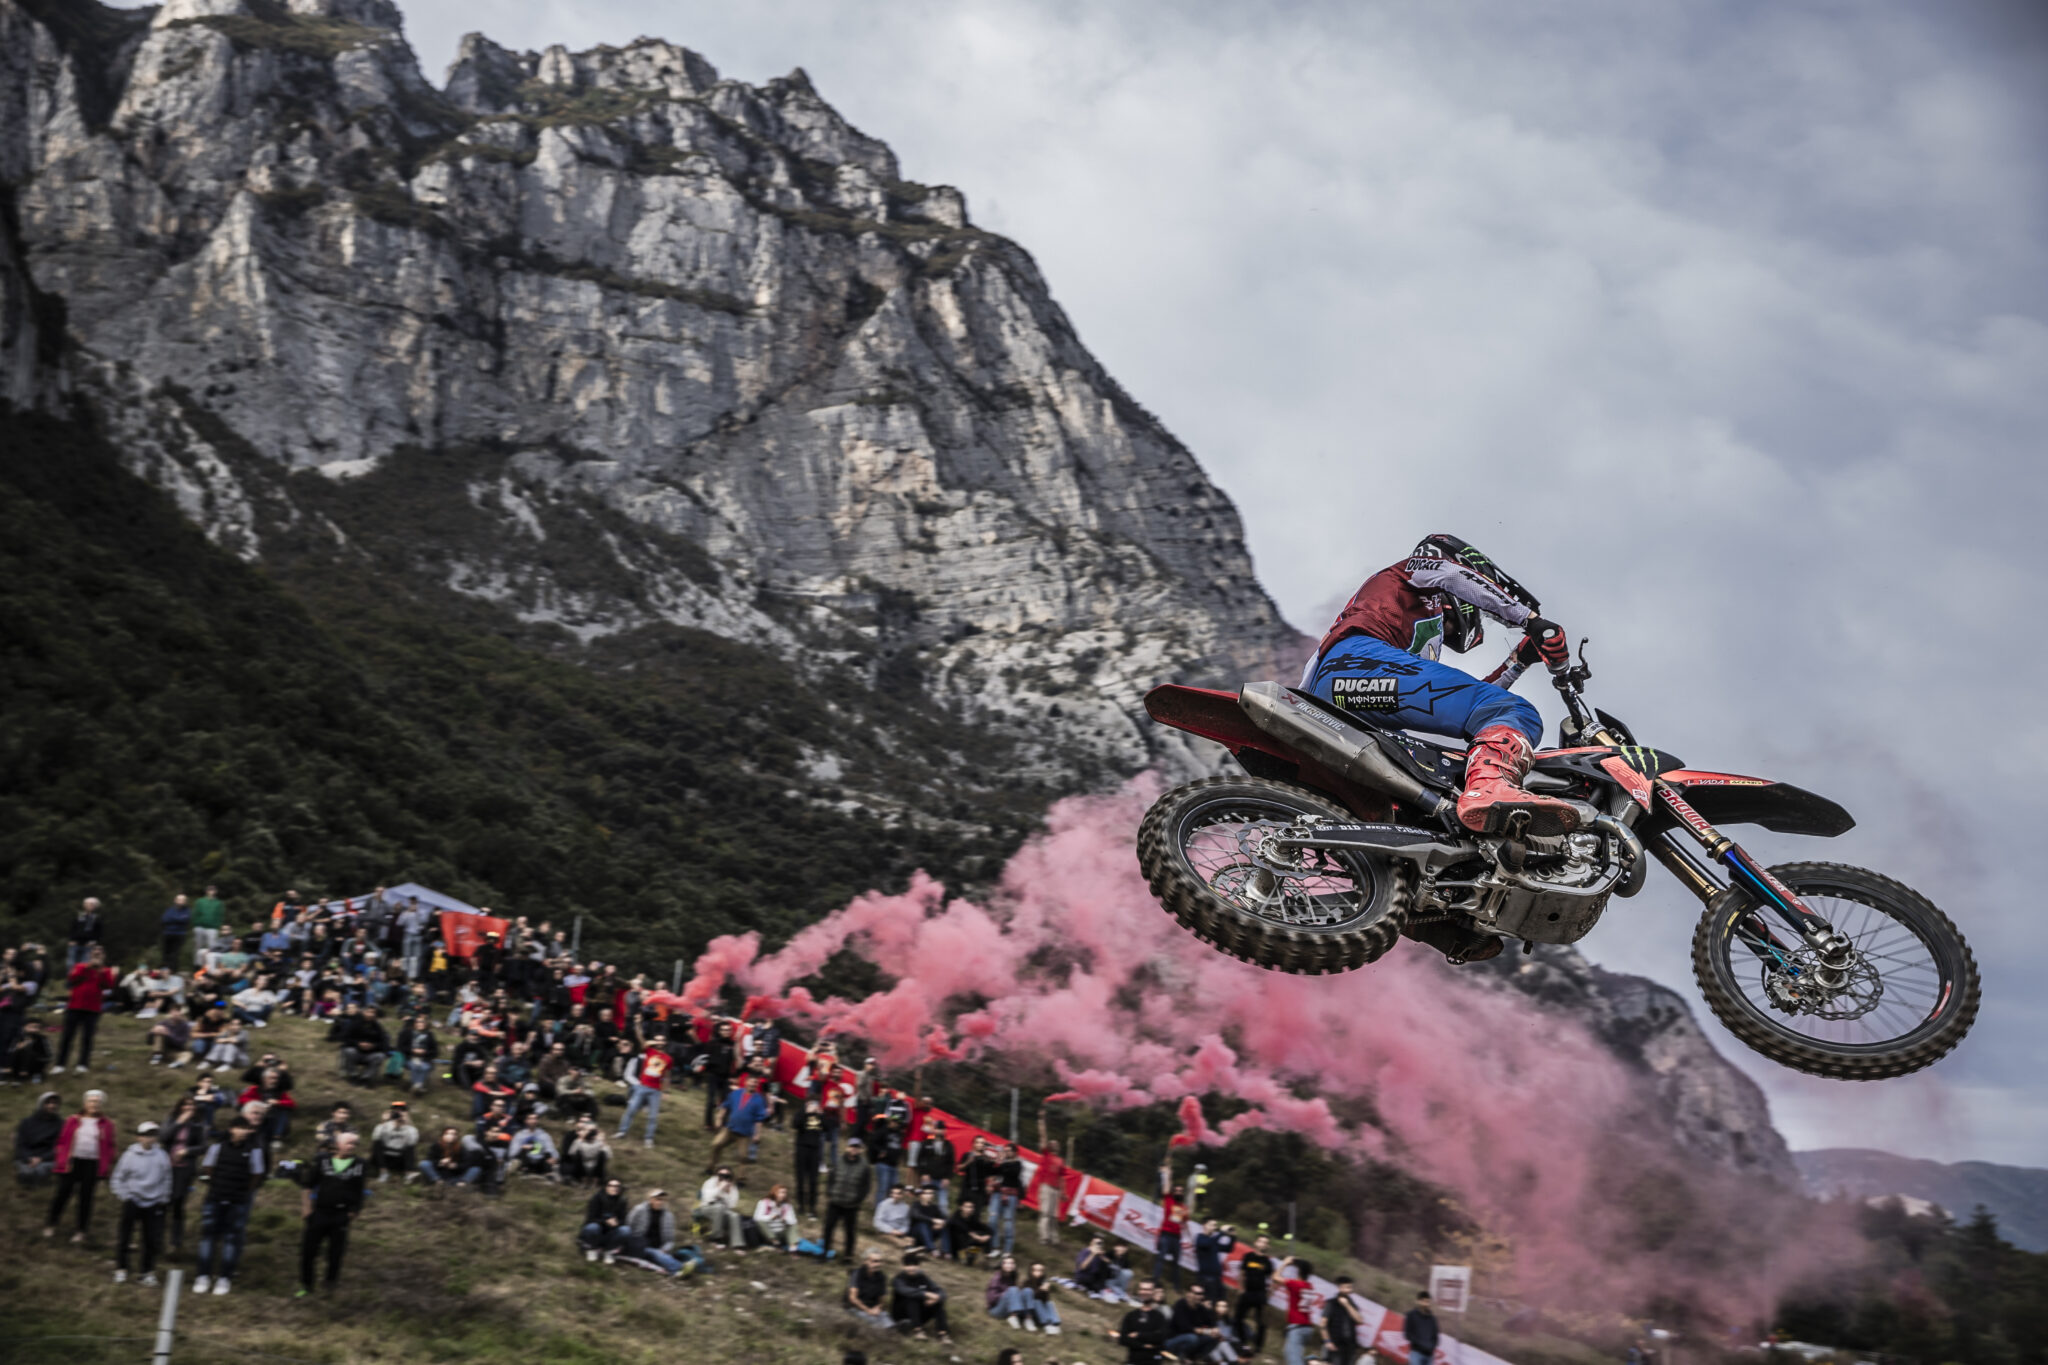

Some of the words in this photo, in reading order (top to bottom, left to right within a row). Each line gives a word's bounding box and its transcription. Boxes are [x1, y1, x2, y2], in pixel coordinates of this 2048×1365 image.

[1333, 679, 1397, 692] DUCATI
[1347, 695, 1396, 703] MONSTER
[1659, 788, 1712, 831] SHOWA
